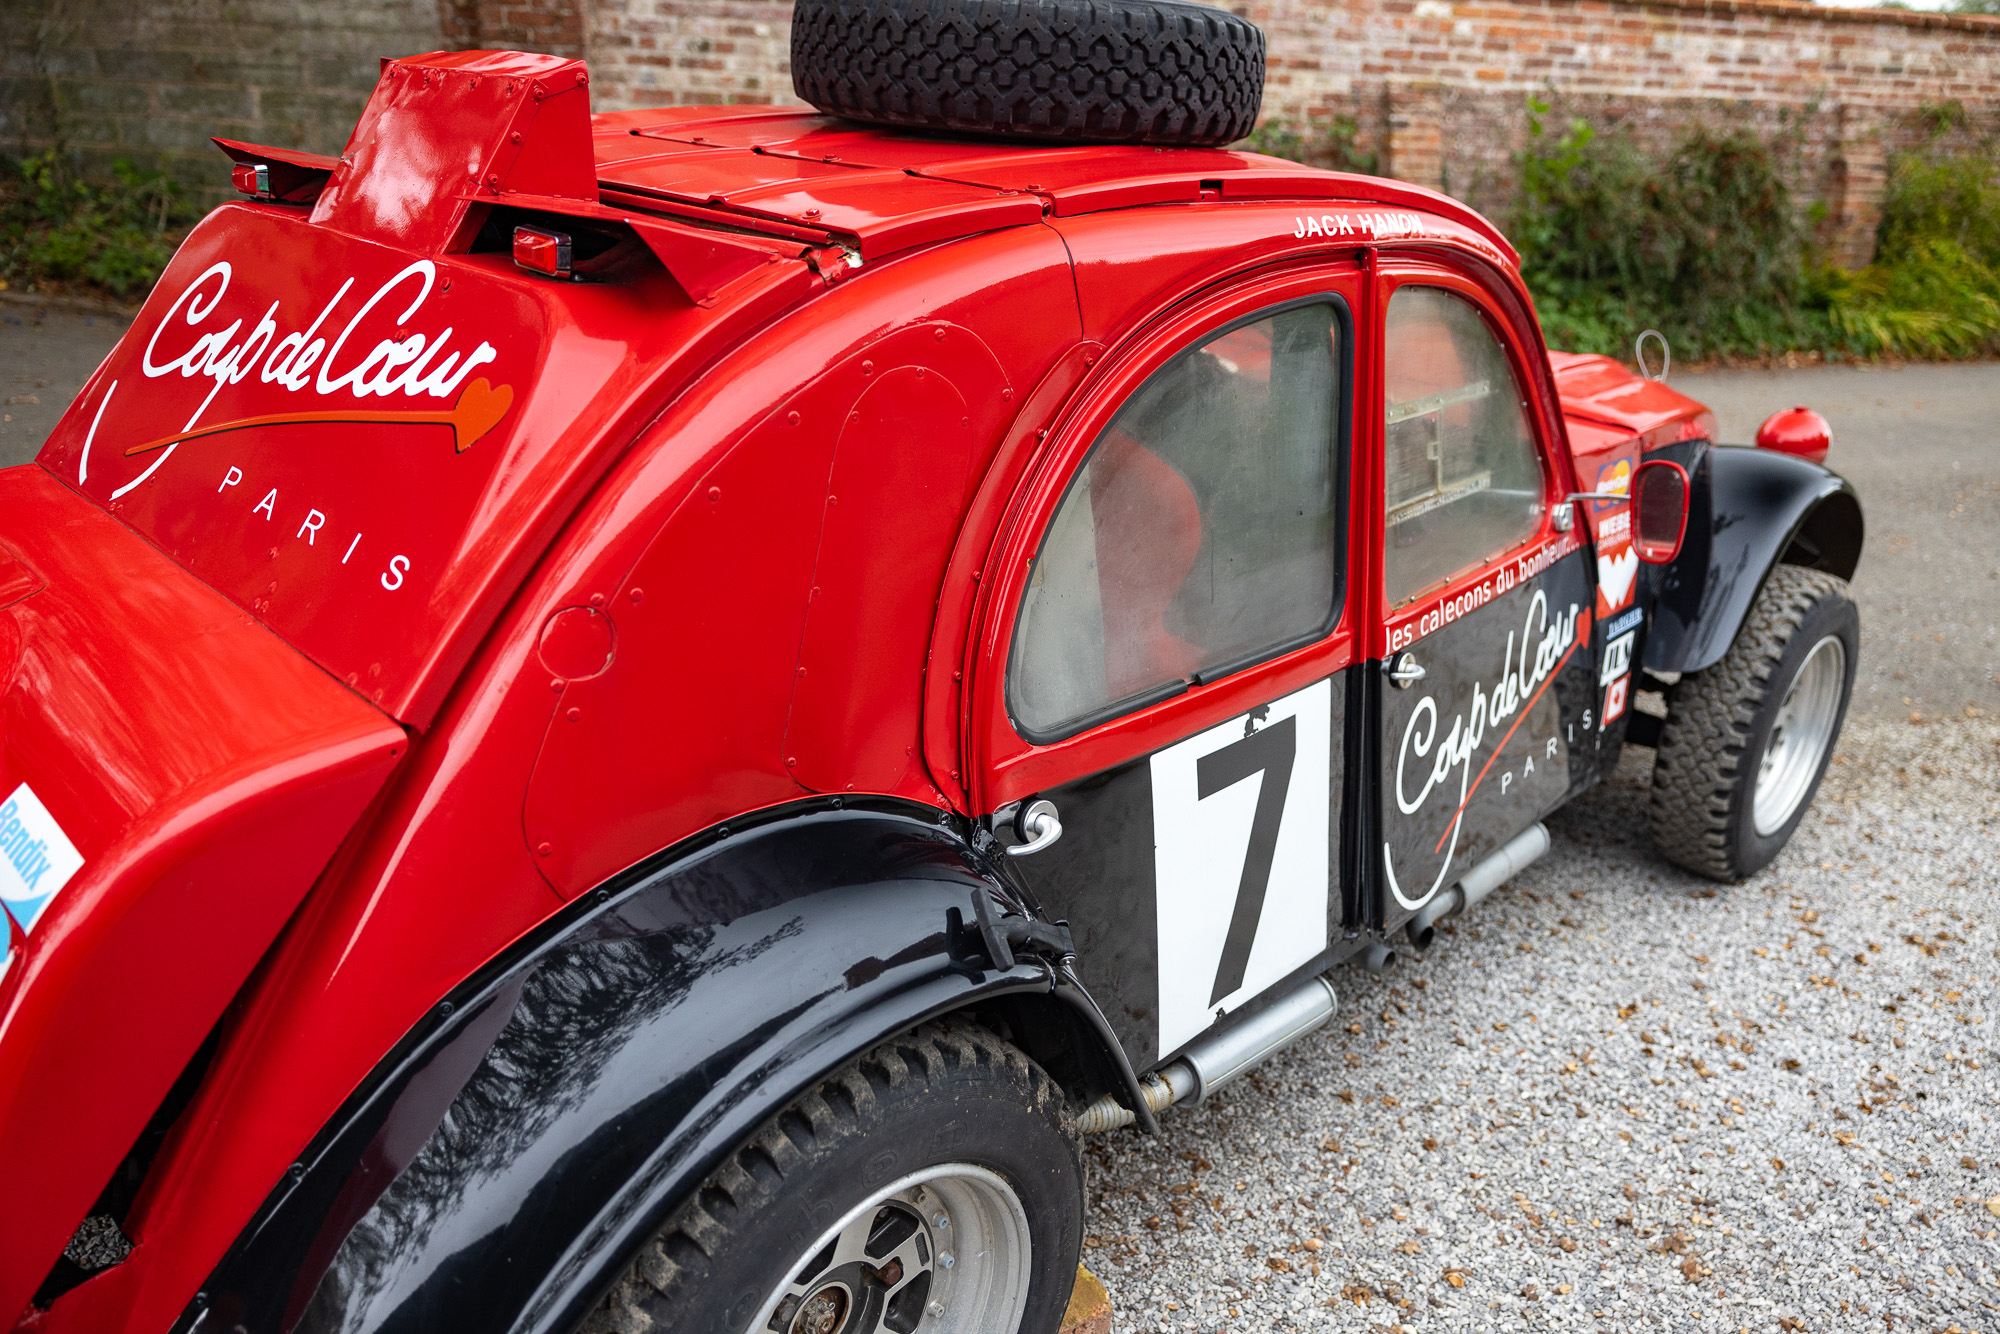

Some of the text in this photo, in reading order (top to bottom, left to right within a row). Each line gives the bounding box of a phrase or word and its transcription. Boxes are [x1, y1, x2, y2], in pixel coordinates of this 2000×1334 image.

[1294, 214, 1354, 238] JACK
[260, 277, 354, 392] de
[217, 466, 411, 591] PARIS
[1598, 510, 1631, 539] WEBE
[1386, 623, 1413, 655] les
[1496, 567, 1515, 595] du
[1489, 629, 1518, 728] de
[1501, 709, 1592, 796] PARIS
[0, 799, 52, 892] Bendix
[1197, 714, 1296, 1010] 7
